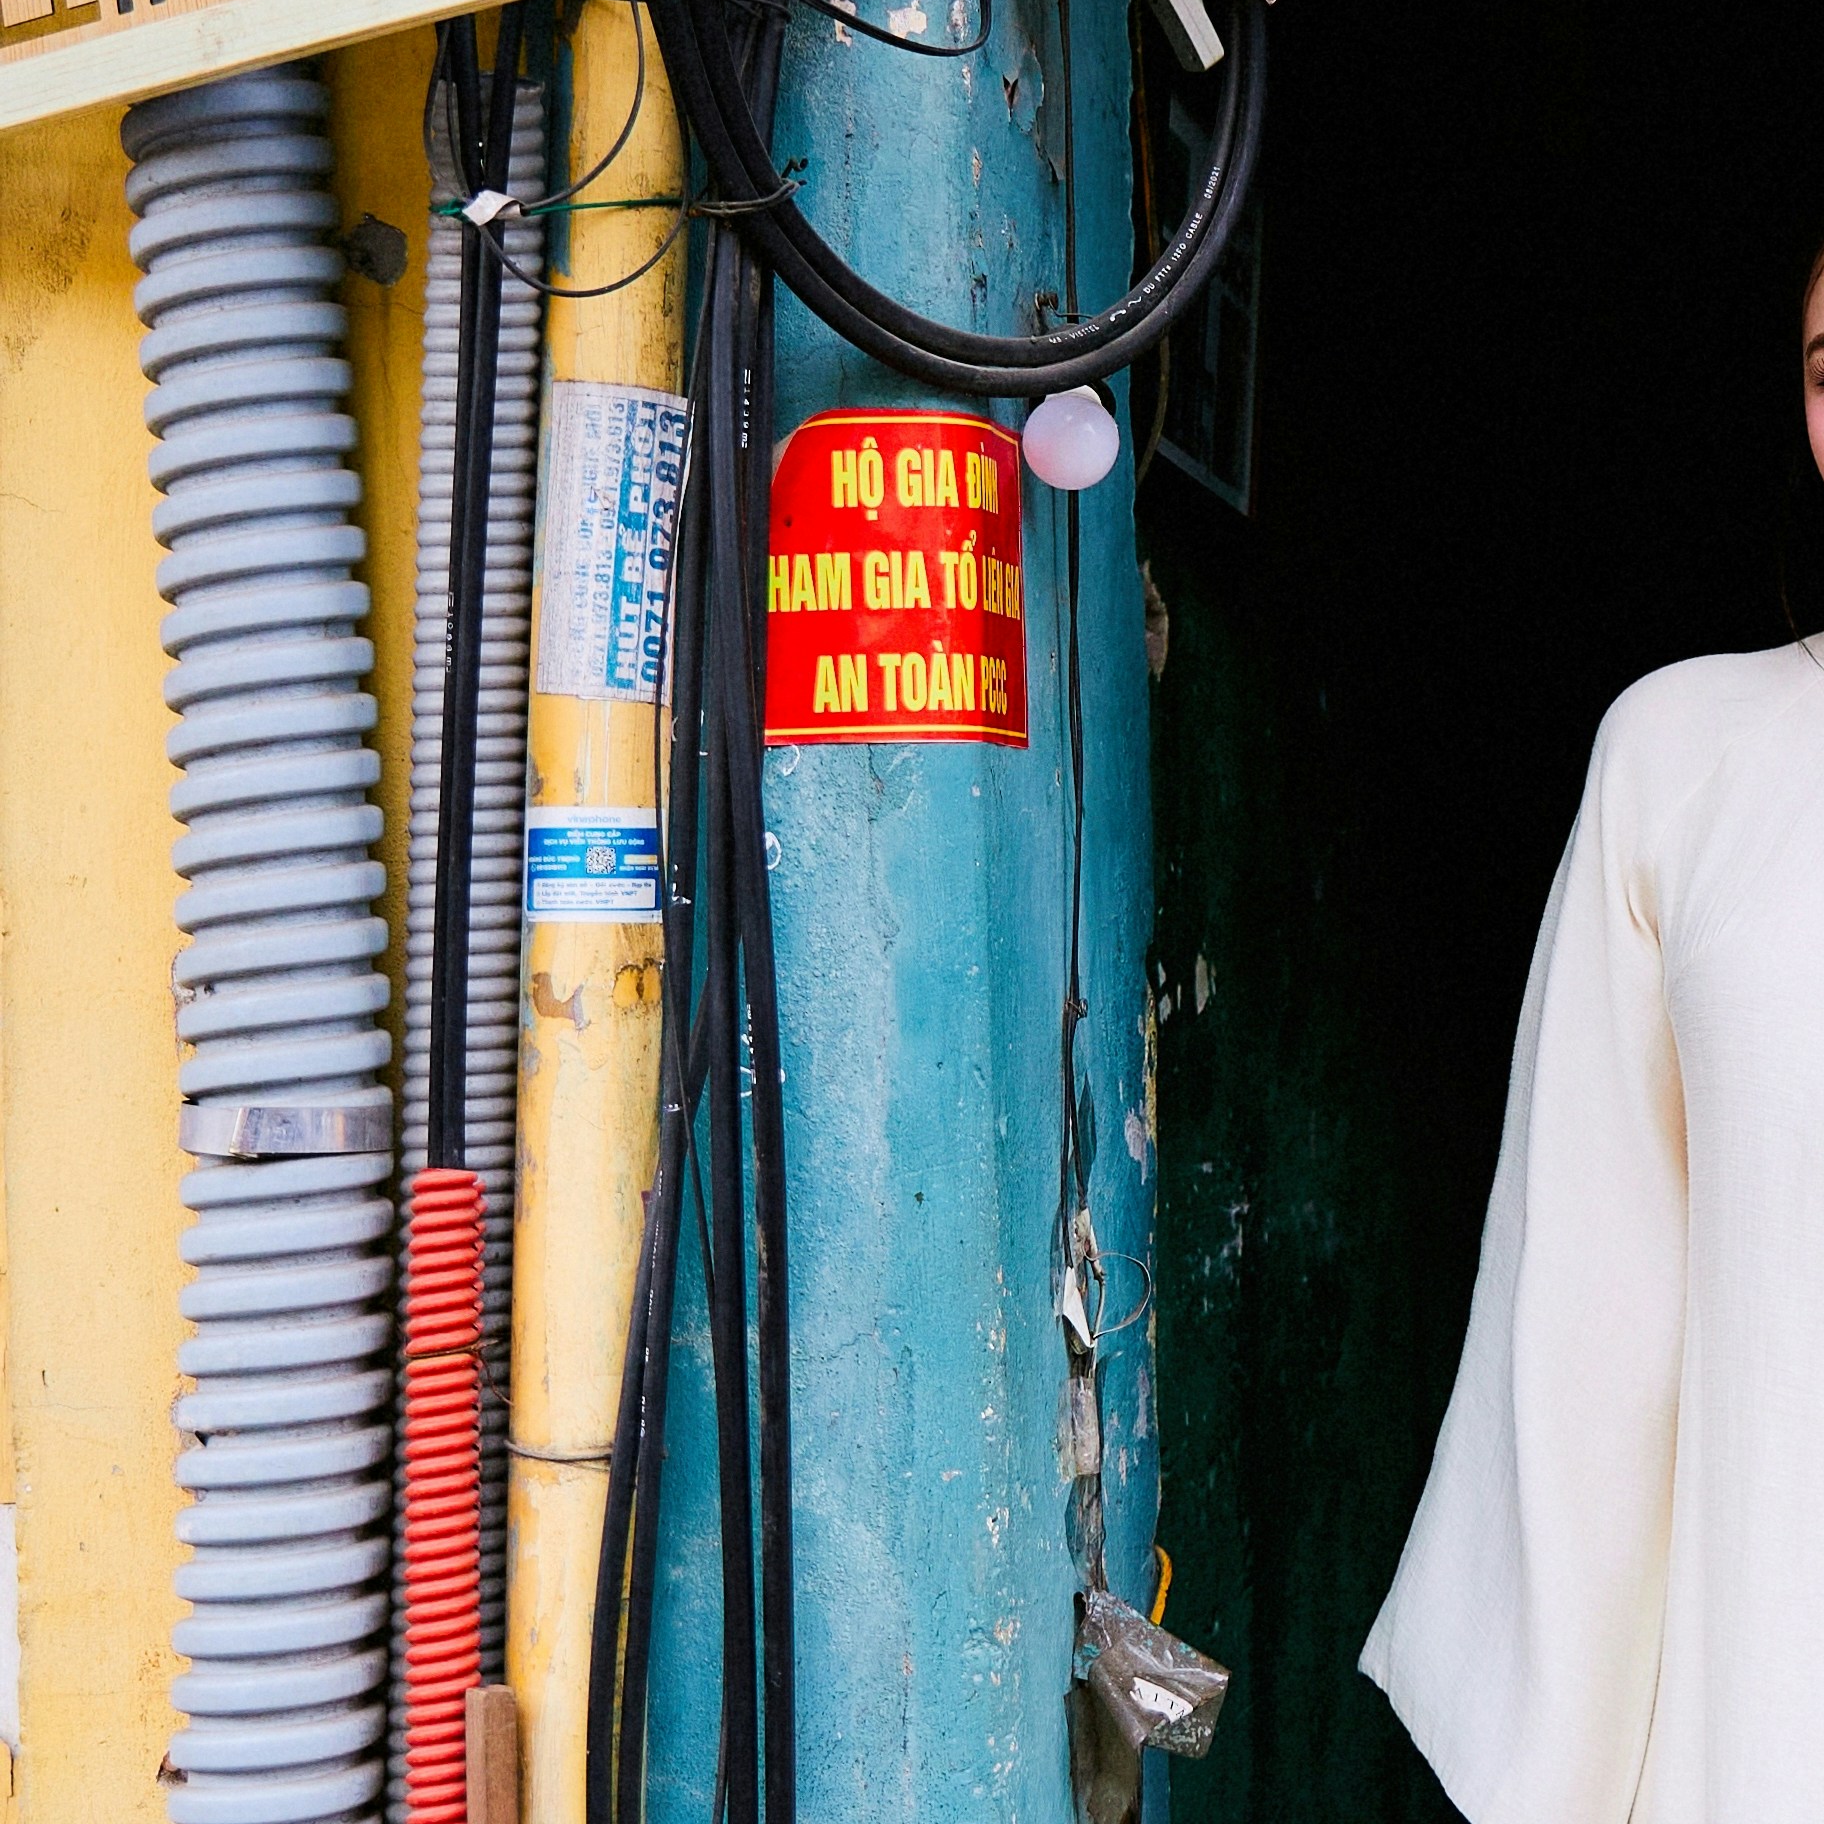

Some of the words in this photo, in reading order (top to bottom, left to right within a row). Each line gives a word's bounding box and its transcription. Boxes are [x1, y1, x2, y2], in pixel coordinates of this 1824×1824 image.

[1069, 323, 1101, 340] VIETTEL
[1142, 282, 1156, 295] DU
[1184, 212, 1203, 239] CABLE
[831, 436, 884, 521] HỘ
[896, 447, 960, 509] GIA
[863, 549, 931, 612] GIA
[939, 529, 978, 612] TỔ
[812, 654, 869, 714] AN
[877, 639, 975, 713] TOÀN
[980, 655, 1008, 716] PCCC
